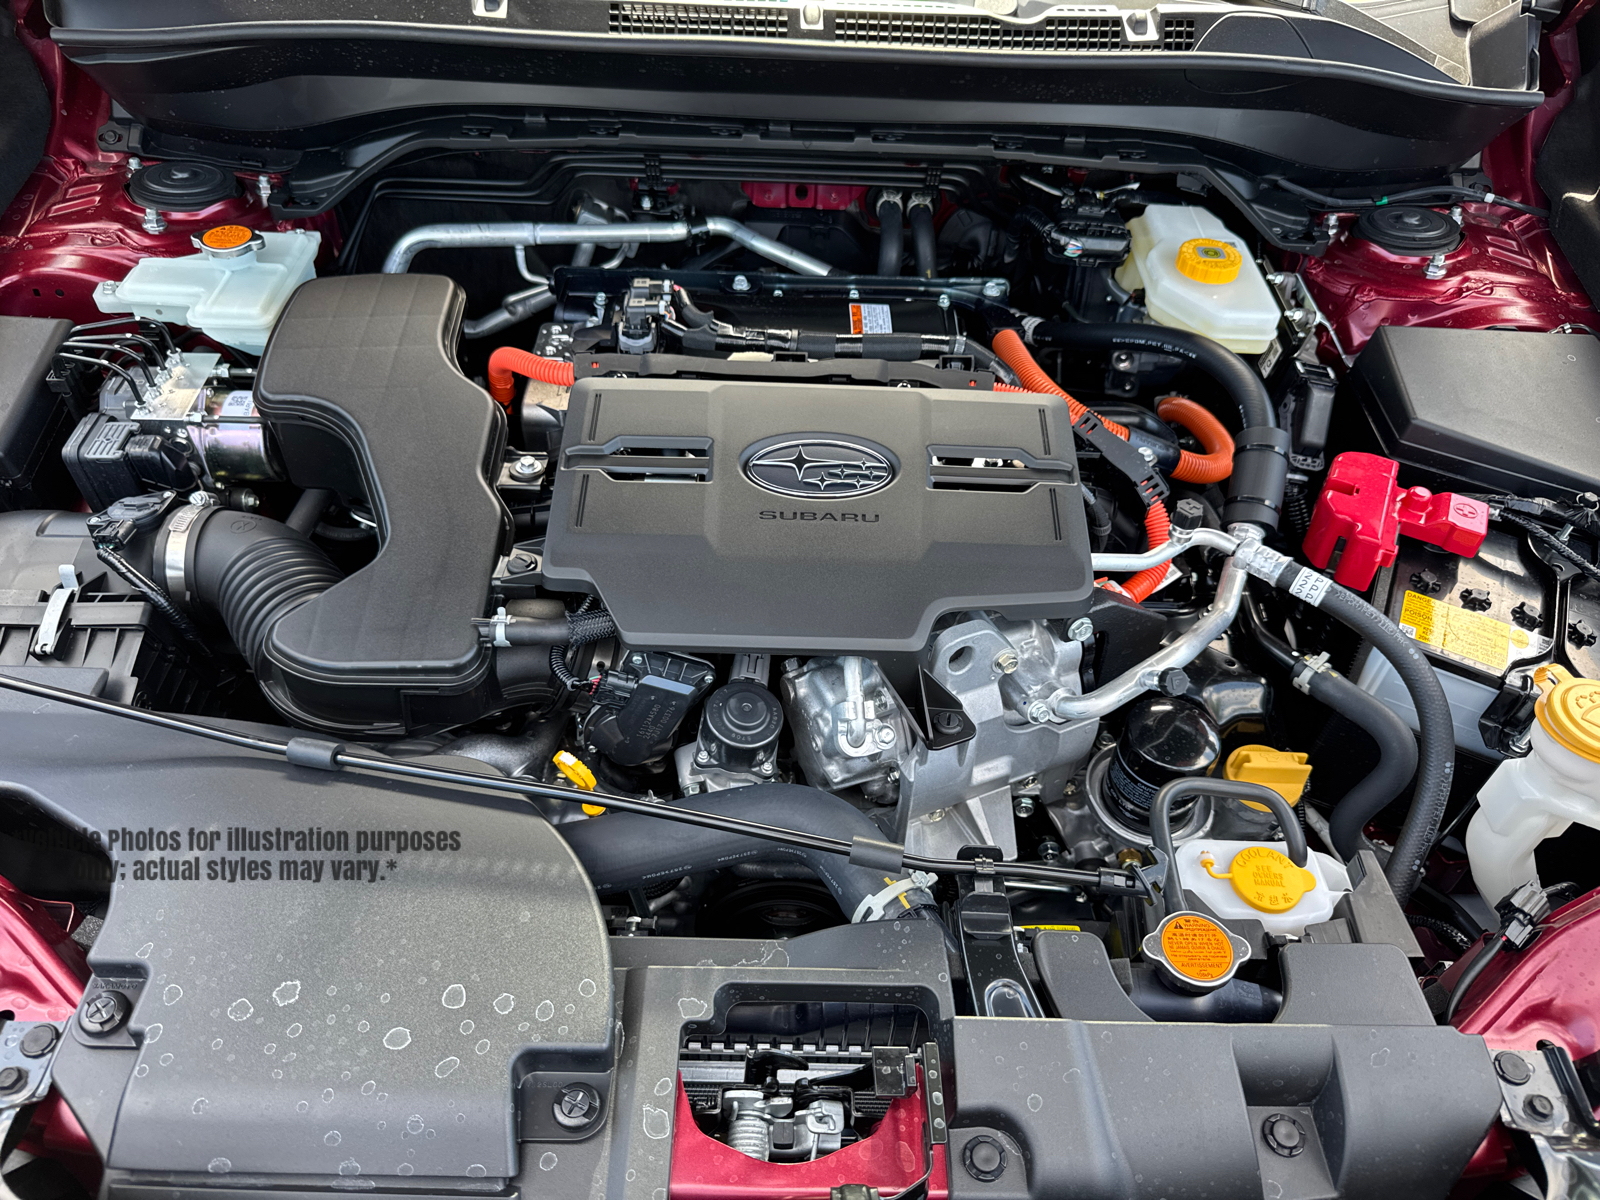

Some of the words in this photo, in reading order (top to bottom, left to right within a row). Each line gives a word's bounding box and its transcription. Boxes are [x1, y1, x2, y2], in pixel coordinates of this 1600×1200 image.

[759, 510, 880, 523] SUBARU
[1404, 607, 1433, 622] POISON
[1235, 848, 1294, 869] COOLANT
[1254, 879, 1286, 888] MANUAL
